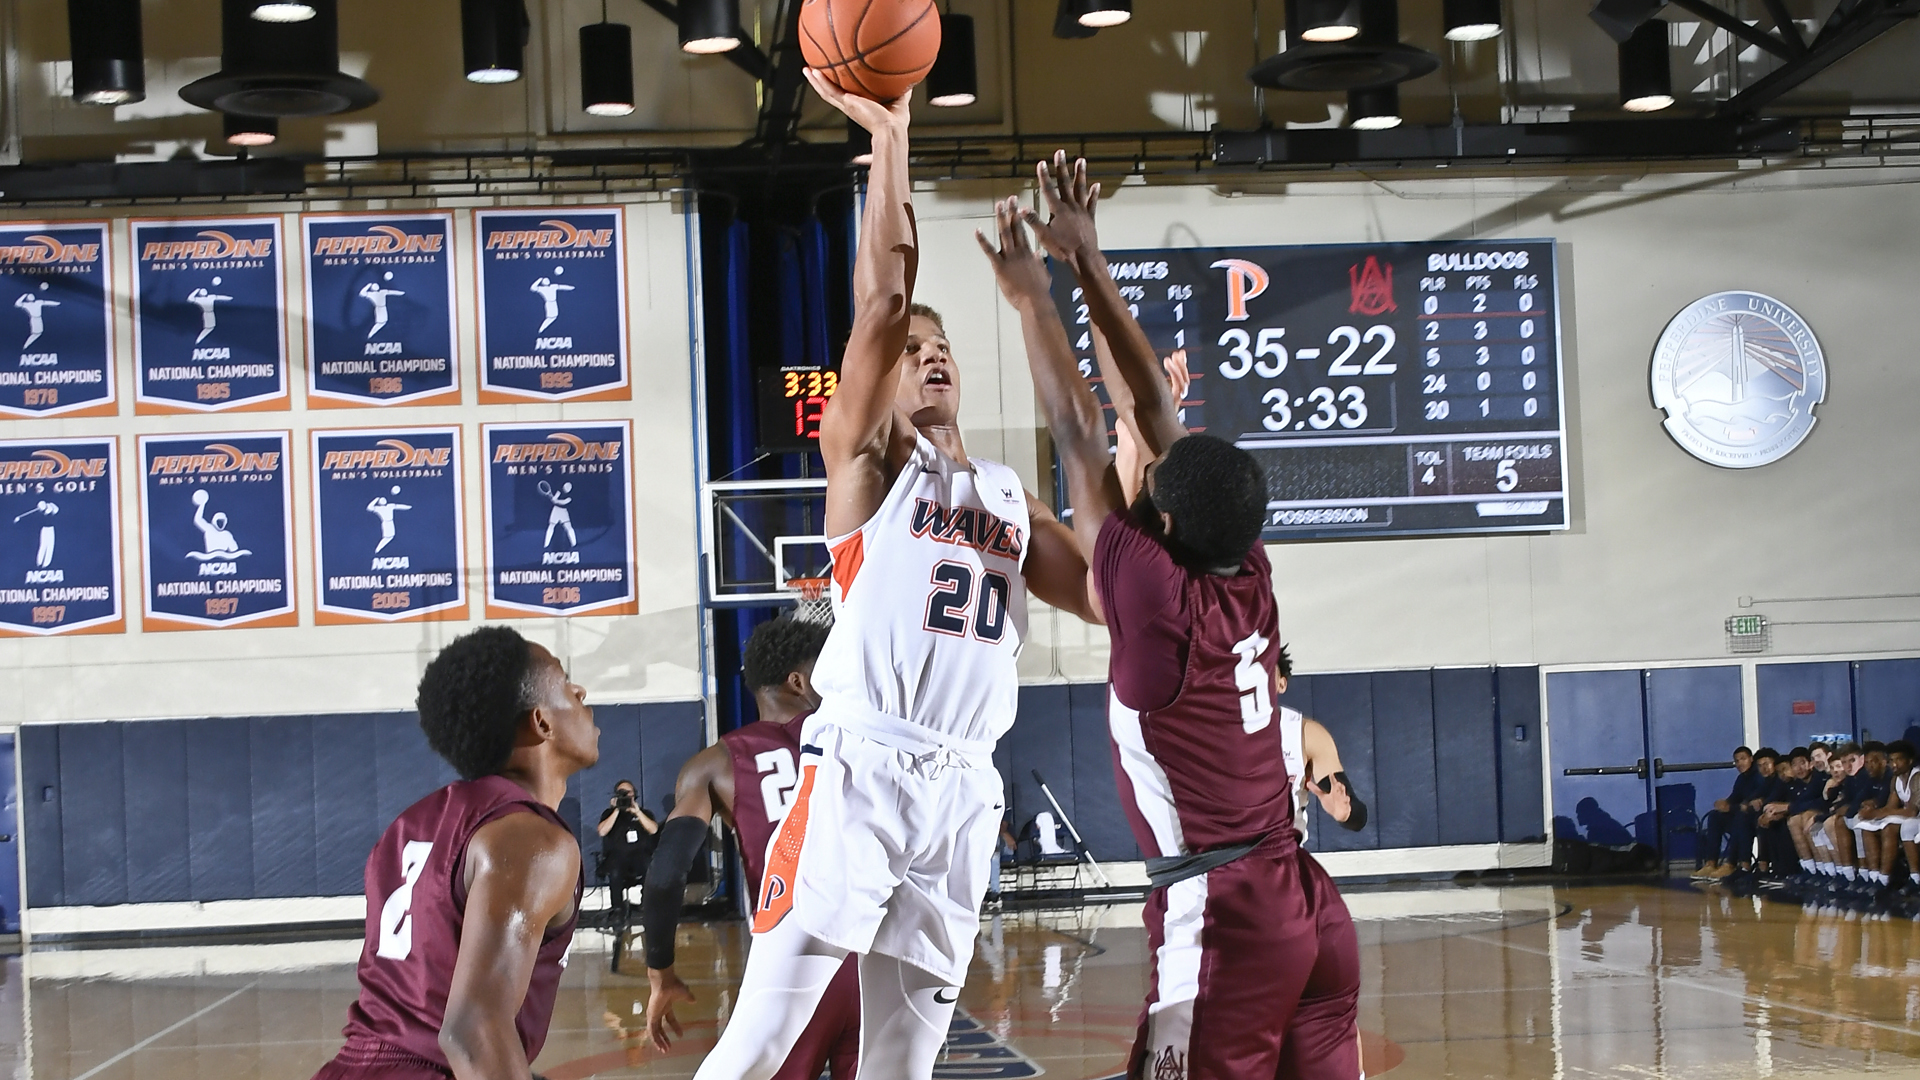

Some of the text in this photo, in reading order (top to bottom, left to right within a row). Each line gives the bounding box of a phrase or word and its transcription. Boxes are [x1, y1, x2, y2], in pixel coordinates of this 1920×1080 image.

[313, 225, 444, 256] PEPPERDINE
[485, 220, 613, 249] PEPPERDINE
[141, 230, 272, 261] PEPPERDINE
[323, 255, 437, 265] MEN'S VOLLEYBALL
[496, 250, 605, 259] MEN'S VOLLEYBALL
[1428, 251, 1530, 272] BULLDOGS
[194, 261, 264, 269] VOLLEYBALL
[1466, 275, 1492, 290] PTS
[1514, 274, 1539, 290] FLS
[1167, 284, 1193, 301] FLS
[1424, 293, 1533, 315] 0 2 0
[1075, 302, 1184, 324] 2 1
[1425, 319, 1535, 341] 2 3 0
[535, 336, 572, 350] NCAA
[1075, 328, 1185, 351] 4 1
[1659, 297, 1820, 383] PEPPERDINE UNIVERSITY
[192, 347, 230, 361] NCAA
[364, 342, 402, 355] NCAA
[1217, 324, 1398, 381] 35-22
[1426, 346, 1536, 368] 5 3 0
[20, 353, 58, 366] NCAA
[321, 358, 446, 375] NATIONAL CHAMPIONS
[493, 353, 615, 370] NATIONAL CHAMPIONS
[1078, 358, 1092, 378] 5
[35, 369, 102, 384] CHAMPIONS
[149, 364, 274, 381] NATIONAL CHAMPIONS
[540, 372, 573, 388] 1992
[784, 371, 838, 398] 3:33
[1422, 371, 1537, 394] 24 0 0
[24, 388, 58, 405] 1978
[197, 383, 230, 400] 1985
[1261, 385, 1369, 431] 3:33
[1424, 397, 1538, 420] 30 1 0
[321, 438, 451, 470] PEPPERDINE
[492, 432, 621, 463] PEPPERDINE
[1461, 444, 1553, 461] TEAM FOULS
[150, 443, 280, 475] PEPPERDINE
[1414, 450, 1444, 466] TOL
[331, 469, 444, 480] MEN'S VOLLEYBALL
[507, 463, 613, 475] MEN'S TENNIS
[1421, 466, 1437, 486] 4
[1495, 459, 1519, 493] 5
[53, 481, 96, 492] GOLF
[159, 473, 273, 484] MEN'S WATER POLO
[1272, 508, 1369, 526] POSSESSION
[909, 497, 1024, 562] WAVES
[371, 556, 409, 570] NCAA
[542, 551, 580, 565] NCAA
[26, 570, 64, 583] NCAA
[199, 562, 237, 575] NCAA
[500, 568, 623, 585] NATIONAL CHAMPIONS
[157, 579, 282, 596] NATIONAL CHAMPIONS
[329, 573, 452, 590] NATIONAL CHAMPIONS
[42, 586, 109, 600] CHAMPIONS
[371, 592, 410, 609] 2005
[543, 587, 581, 604] 2006
[205, 598, 239, 615] 1997
[922, 559, 1012, 645] 20
[32, 606, 66, 623] 1997
[1737, 617, 1757, 634] EXIT
[1231, 631, 1274, 735] 5
[376, 840, 434, 961] 2
[763, 874, 787, 912] P
